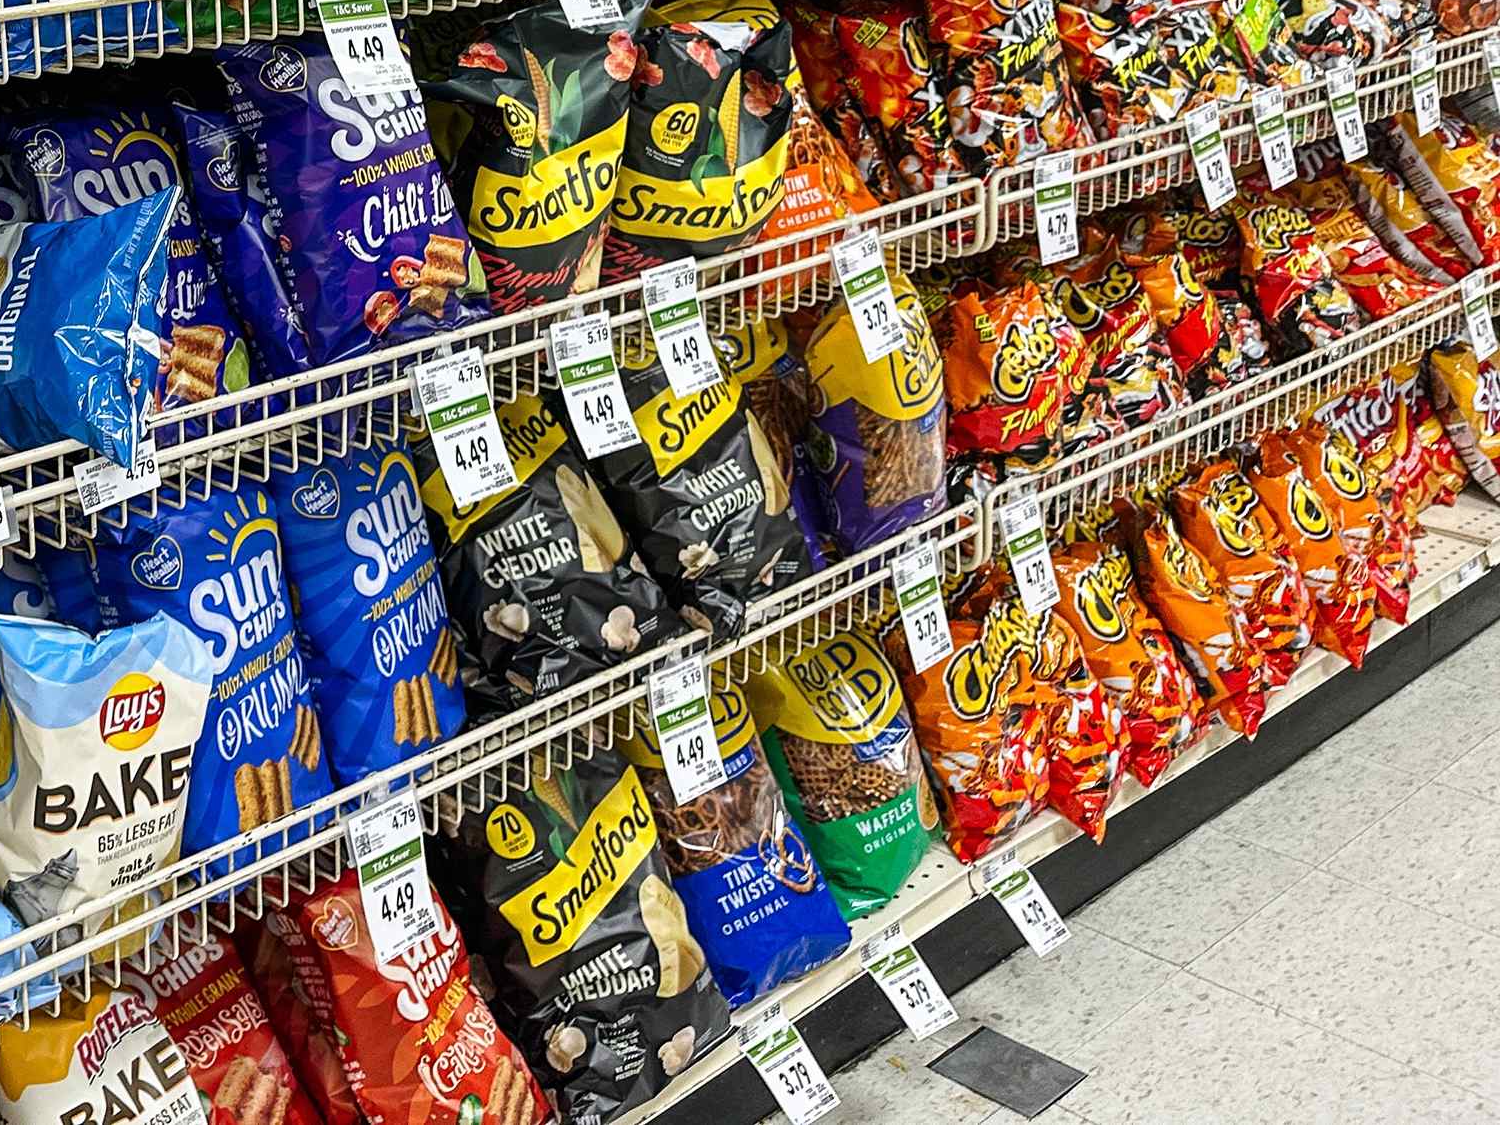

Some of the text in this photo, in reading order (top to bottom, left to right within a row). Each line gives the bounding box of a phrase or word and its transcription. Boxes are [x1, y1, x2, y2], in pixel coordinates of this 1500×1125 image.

[333, 3, 372, 15] T&C Saver
[348, 36, 384, 63] 4.49
[667, 110, 697, 133] 60
[1344, 117, 1359, 137] 4.79
[1270, 141, 1286, 161] 4.79
[1206, 161, 1223, 181] 4.79
[674, 273, 694, 289] 5.19
[863, 301, 888, 331] 3.79
[587, 330, 608, 344] 5.19
[672, 336, 700, 367] 4.49
[458, 367, 482, 384] 4.79
[585, 394, 614, 425] 4.49
[455, 436, 489, 470] 4.49
[685, 459, 746, 498] WHITE
[477, 511, 552, 557] WHITE
[141, 547, 169, 571] Heart
[483, 537, 577, 589] CHEDDAR
[190, 549, 283, 675] Sun
[915, 611, 938, 641] 3.79
[682, 670, 701, 688] 5.19
[101, 684, 165, 735] Lay's
[677, 736, 703, 768] 4.49
[98, 810, 177, 853] 65% LESS FAT
[392, 810, 416, 829] 4.79
[492, 812, 521, 837] 70
[856, 801, 913, 835] WAFFLES
[864, 822, 916, 853] ORIGINAL
[111, 863, 157, 887] vinegar
[532, 791, 650, 945] Smartfood
[381, 882, 415, 922] 4.49
[900, 978, 931, 1009] 3.79
[76, 996, 153, 1070] RUFFLES
[780, 1062, 808, 1095] 3.79
